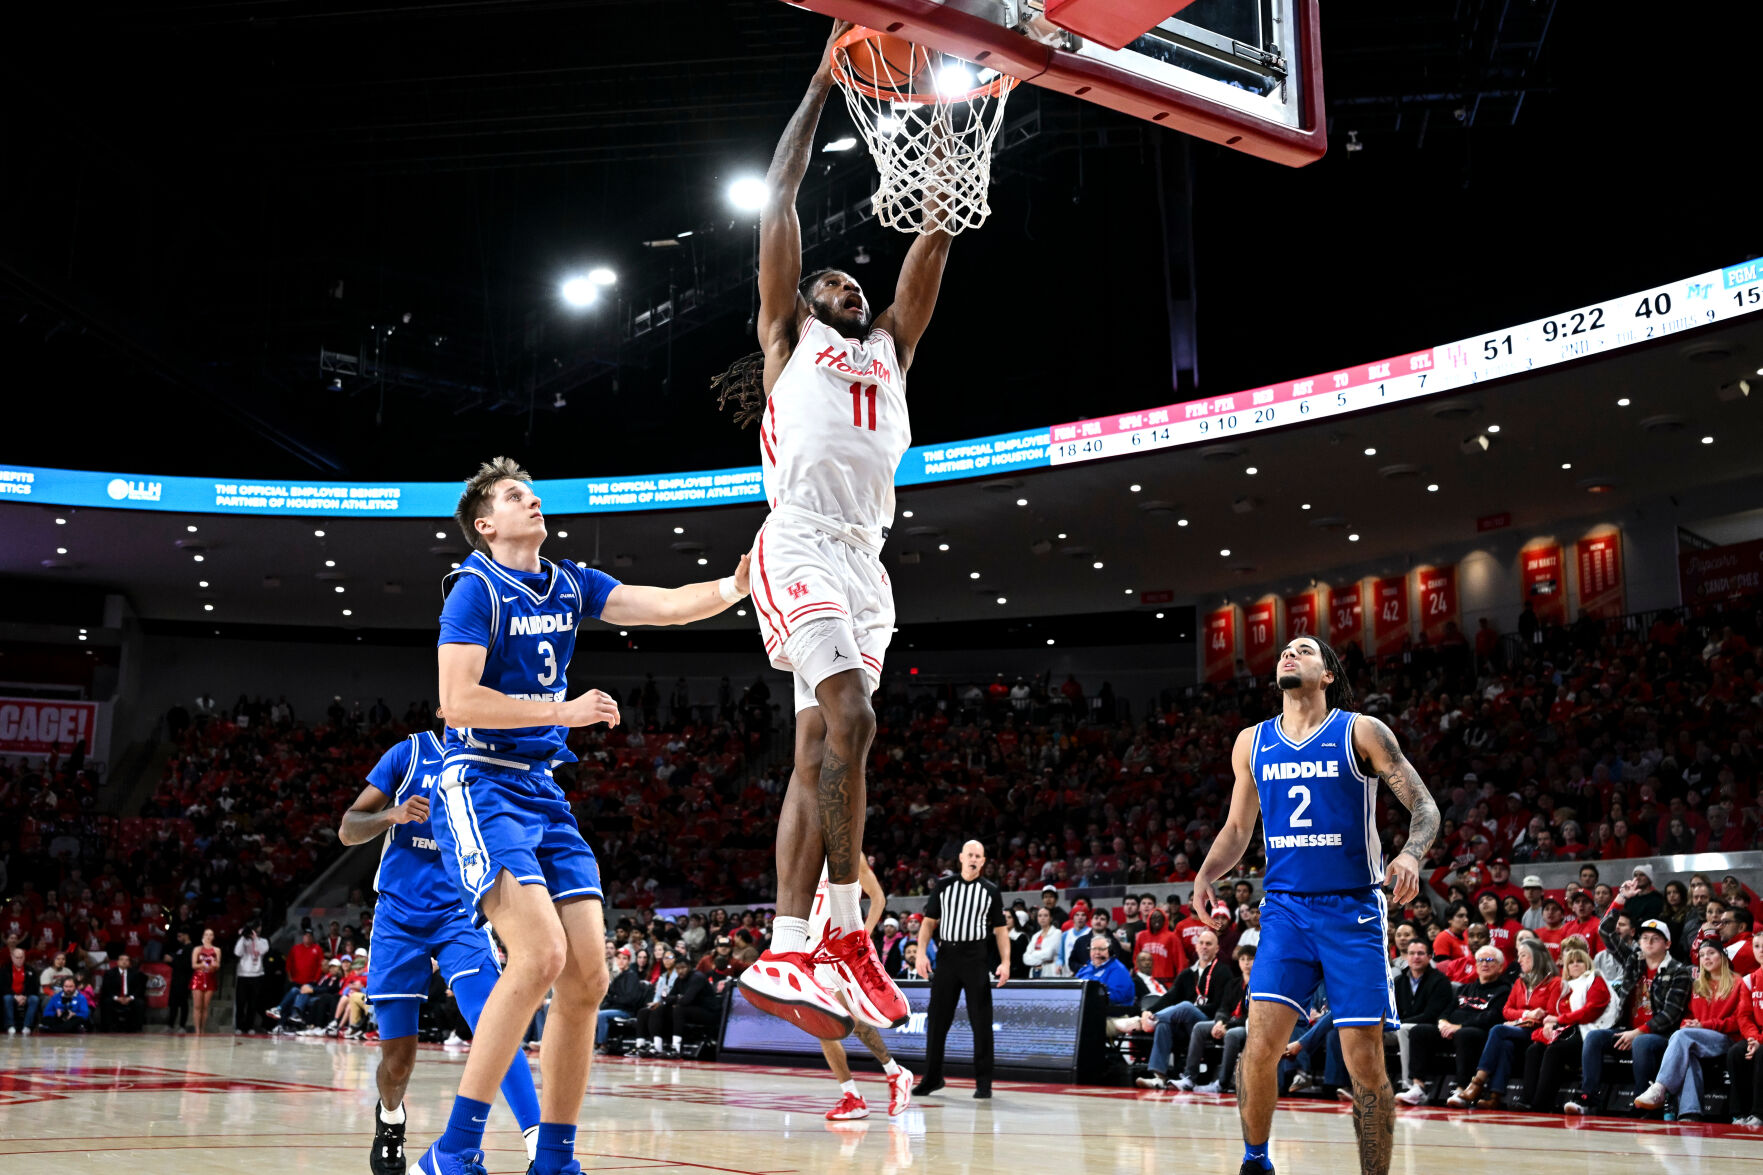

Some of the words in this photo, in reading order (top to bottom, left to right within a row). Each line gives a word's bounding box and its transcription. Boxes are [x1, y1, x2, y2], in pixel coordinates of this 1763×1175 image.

[1635, 292, 1671, 319] 40
[1733, 286, 1761, 307] 15
[1542, 307, 1605, 342] 9:22
[1706, 309, 1715, 323] 9
[1484, 335, 1513, 360] 51
[1378, 383, 1385, 397] 1
[1417, 374, 1427, 388] 7
[849, 381, 877, 431] 11
[1300, 400, 1309, 414] 6
[1337, 392, 1347, 406] 5
[1199, 421, 1208, 434] 9
[1218, 415, 1237, 430] 10
[1254, 407, 1275, 423] 20
[1132, 433, 1140, 446] 6
[1152, 428, 1170, 442] 14
[923, 449, 945, 462] THE
[945, 443, 993, 459] OFFICIAL
[994, 434, 1050, 453] EMPLOYEE
[1059, 444, 1076, 457] 18
[1083, 439, 1103, 453] 40
[925, 459, 974, 475] PARTNER
[975, 455, 990, 468] OF
[991, 448, 1044, 465] HOUSTON
[0, 471, 35, 483] EFITS
[587, 483, 609, 493] THE
[610, 480, 657, 493] OFFICIAL
[658, 476, 713, 490] EMPLOYEE
[714, 471, 762, 486] BENEFITS
[0, 482, 32, 495] ETICS
[215, 484, 238, 495] THE
[239, 485, 289, 497] OFFICIAL
[290, 486, 348, 498] EMPLOYEE
[350, 487, 400, 498] BENEFITS
[589, 494, 637, 506] PARTNER
[638, 492, 655, 503] OF
[655, 489, 706, 502] HOUSTON
[707, 484, 761, 499] ATHLETICS
[215, 496, 267, 508] PARTNER
[268, 497, 285, 508] OF
[286, 497, 339, 510] HOUSTON
[340, 499, 399, 510] ATHLETICS
[1382, 600, 1400, 622] 42
[1429, 591, 1447, 615] 24
[1337, 607, 1353, 630] 34
[1211, 631, 1227, 650] 44
[1252, 624, 1266, 646] 10
[537, 640, 557, 687] 3
[0, 704, 88, 743] CAGE!
[1262, 760, 1340, 781] MIDDLE
[1287, 785, 1312, 828] 2
[1268, 833, 1342, 849] TENNESSEE
